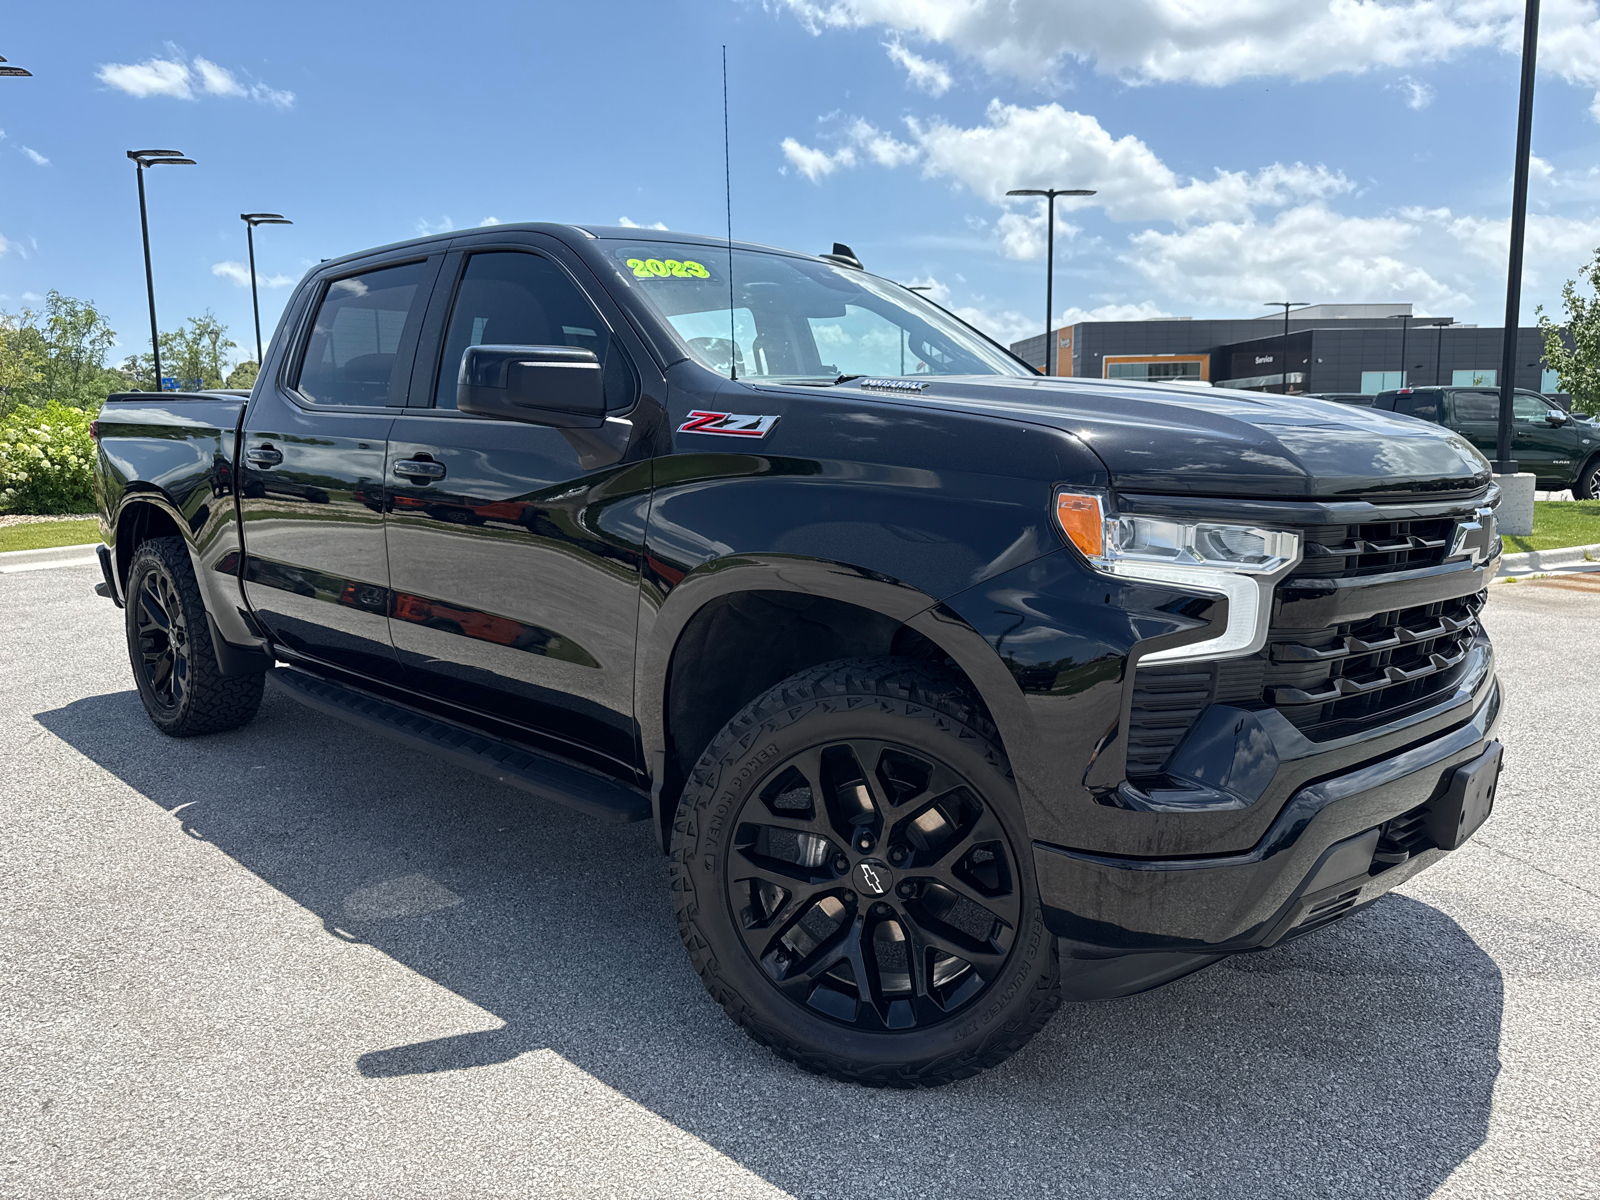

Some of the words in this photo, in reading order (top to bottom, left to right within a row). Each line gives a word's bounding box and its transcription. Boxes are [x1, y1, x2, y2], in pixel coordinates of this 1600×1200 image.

[627, 258, 710, 278] 2023
[1254, 354, 1273, 365] Service
[676, 409, 781, 439] Z71
[706, 790, 736, 847] VENOM
[730, 743, 781, 791] POWER
[980, 960, 1032, 1024] HUNTER
